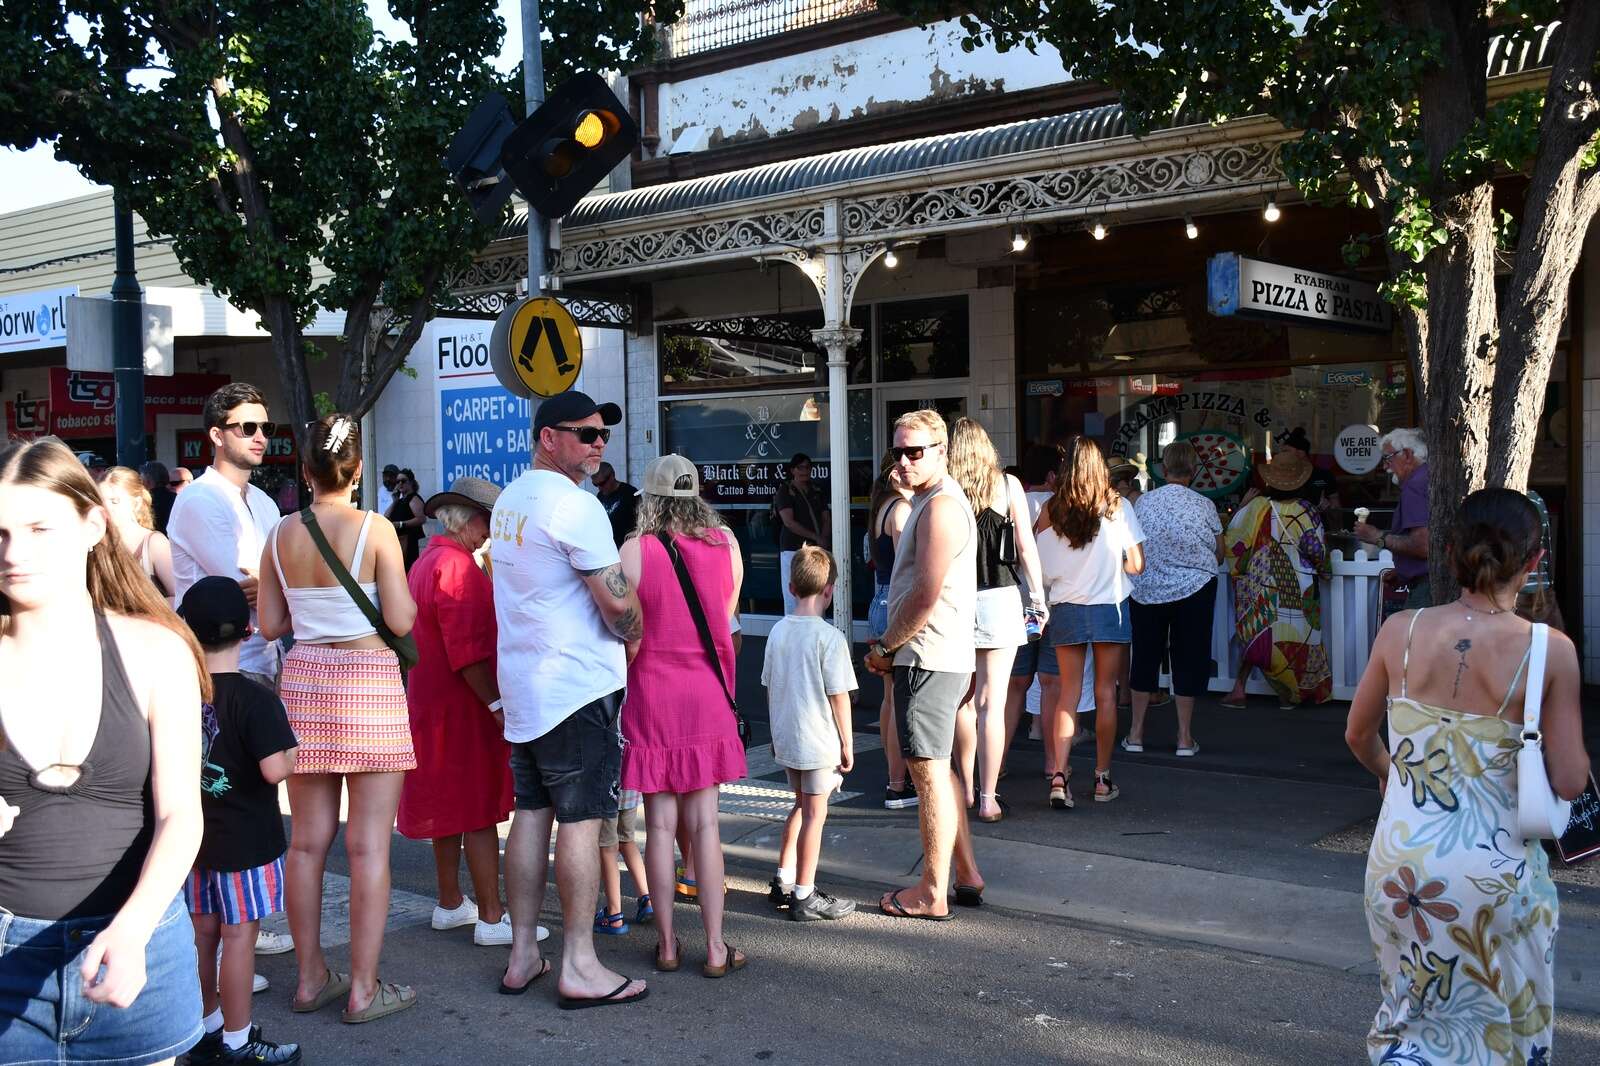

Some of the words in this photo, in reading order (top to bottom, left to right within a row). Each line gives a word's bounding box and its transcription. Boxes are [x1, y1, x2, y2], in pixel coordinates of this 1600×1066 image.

[1294, 273, 1350, 293] KYABRAM
[1251, 280, 1309, 312] PIZZA
[1315, 292, 1328, 314] &
[1332, 295, 1384, 323] PASTA
[460, 332, 484, 343] H&T
[438, 336, 489, 370] Floo
[144, 395, 176, 405] acco
[453, 396, 507, 422] CARPET
[516, 396, 531, 418] TI
[57, 413, 100, 429] tobacco
[104, 414, 117, 426] st
[1111, 397, 1170, 457] BRAM
[1175, 392, 1248, 417] PIZZA
[1254, 407, 1272, 428] &
[184, 440, 203, 458] KY
[454, 432, 492, 454] VINYL
[1340, 437, 1354, 447] WE
[1357, 437, 1377, 447] ARE
[1346, 447, 1371, 457] OPEN
[703, 464, 740, 483] Black
[745, 464, 769, 481] Cat
[774, 463, 787, 480] &
[810, 466, 830, 480] ow
[717, 484, 744, 496] Tattoo
[747, 484, 777, 496] Studio
